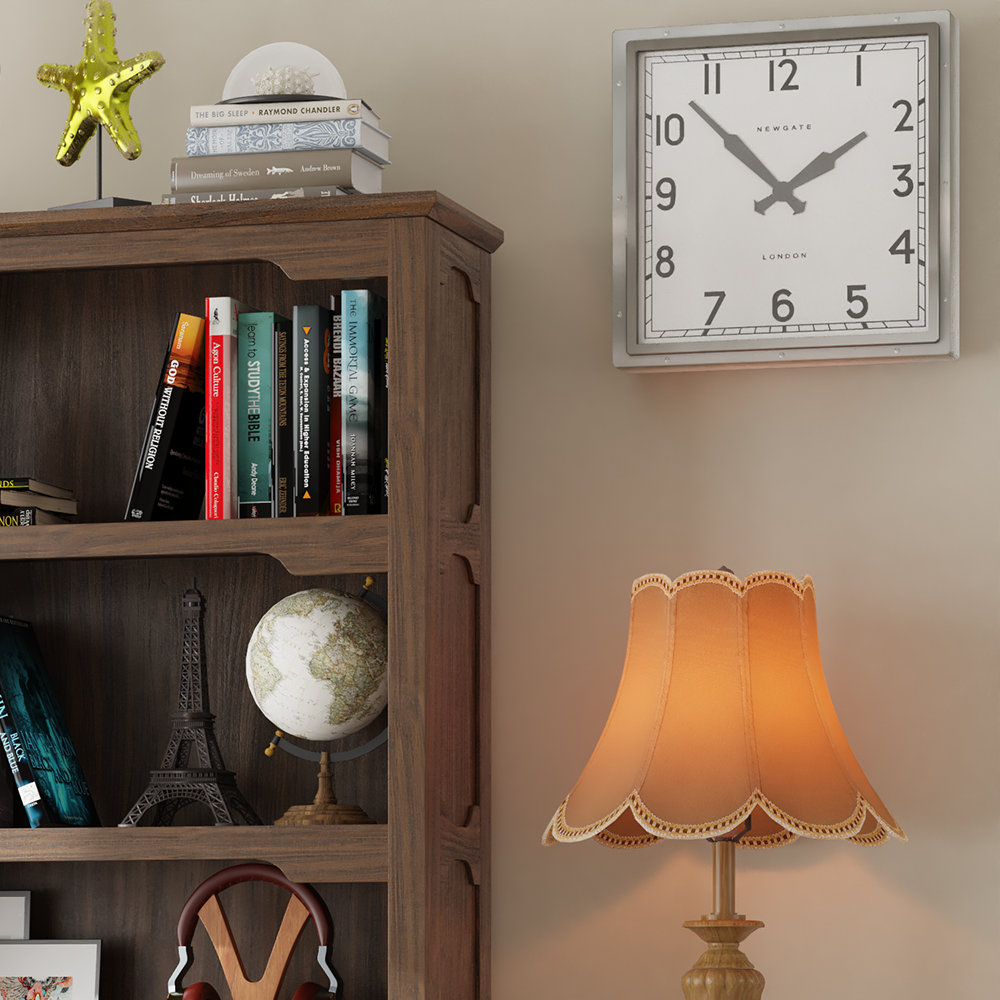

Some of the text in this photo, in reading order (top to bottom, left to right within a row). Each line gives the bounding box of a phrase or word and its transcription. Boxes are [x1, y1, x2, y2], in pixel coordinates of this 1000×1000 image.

[704, 62, 721, 95] 11
[768, 58, 800, 92] 12
[856, 54, 862, 86] 1
[195, 106, 342, 119] THE BIG SLEEP RAYMOND CHANDLER
[756, 124, 813, 132] NEWGATE
[892, 99, 914, 132] 2
[655, 113, 686, 146] 10
[190, 170, 224, 180] Dreaming
[224, 169, 232, 177] of
[233, 168, 260, 177] Sweden
[300, 165, 322, 173] Andrew
[892, 164, 914, 198] 3
[655, 176, 677, 211] 9
[655, 245, 675, 278] 8
[762, 252, 808, 261] LONDON
[888, 228, 916, 264] 4
[704, 290, 726, 326] 7
[771, 288, 795, 322] 6
[846, 284, 869, 320] 5
[248, 322, 258, 347] learn
[279, 331, 287, 353] SAYINGS
[347, 321, 358, 380] IMMORTAL
[212, 342, 220, 364] Agon
[248, 348, 257, 358] to
[279, 354, 287, 367] FROM
[333, 314, 342, 397] BHENDI BAZAAR
[213, 366, 221, 398] Culture
[279, 368, 287, 379] THE
[144, 360, 179, 470] GOD WITHOUT RELIGION
[348, 385, 358, 422] GAME
[279, 477, 287, 489] ERIC
[0, 732, 20, 774] AND BLUE
[10, 732, 26, 762] BLACK
